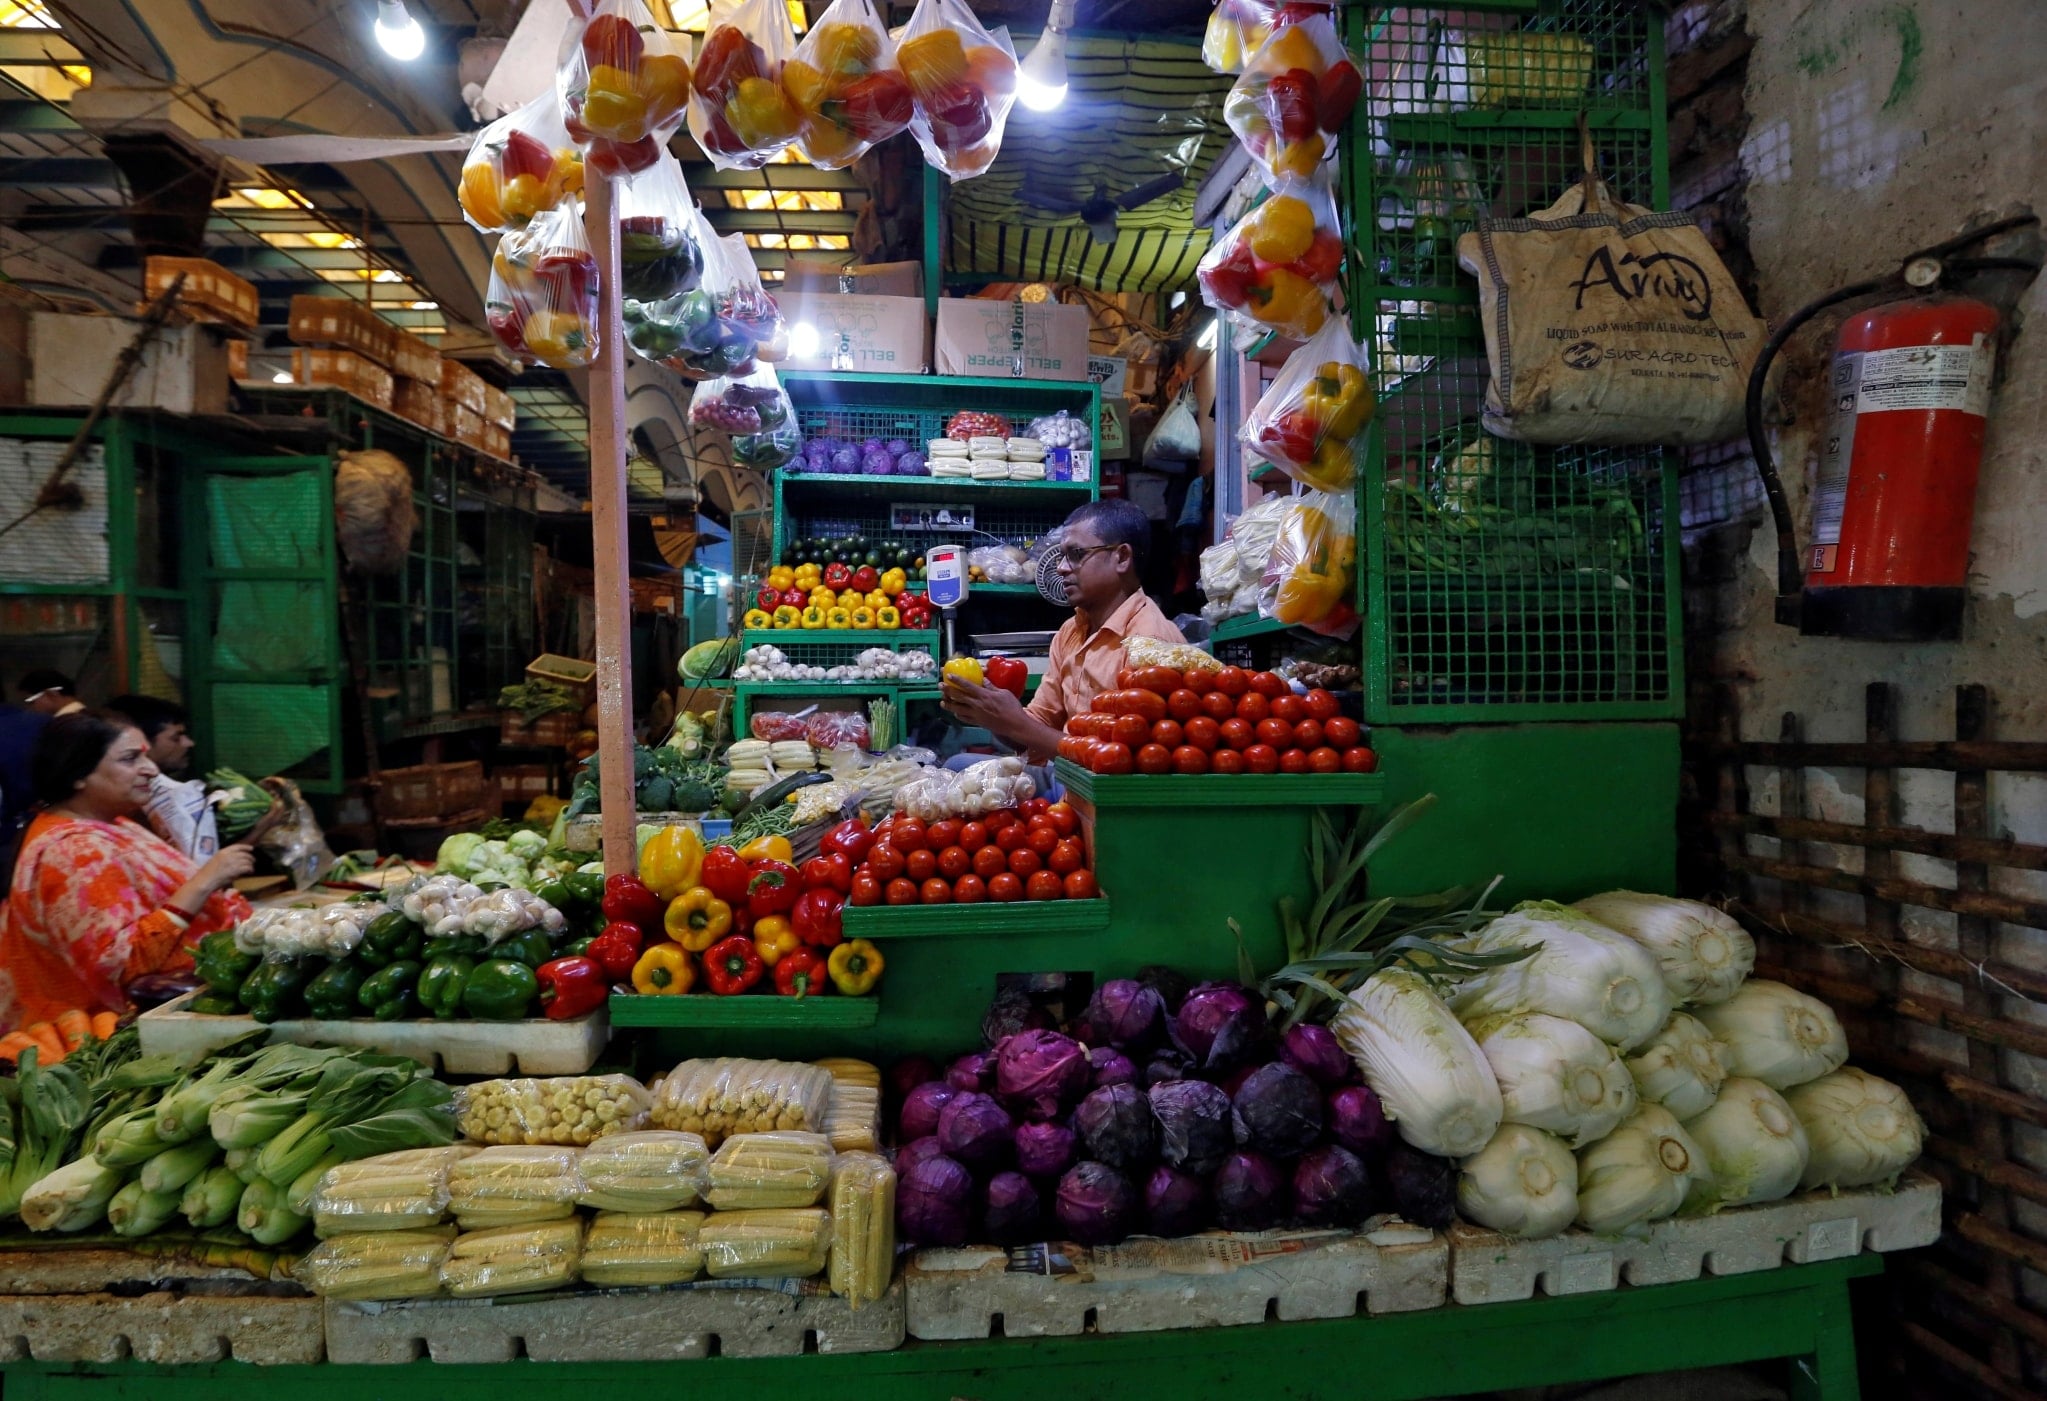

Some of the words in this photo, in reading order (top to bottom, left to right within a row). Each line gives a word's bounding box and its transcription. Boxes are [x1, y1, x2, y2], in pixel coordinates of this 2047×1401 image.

[1547, 327, 1580, 341] LIQUID
[1581, 322, 1610, 337] SOAP
[859, 350, 895, 362] BELL
[1604, 348, 1645, 361] SUR
[1647, 350, 1698, 364] AGRO
[1028, 357, 1062, 371] BELL
